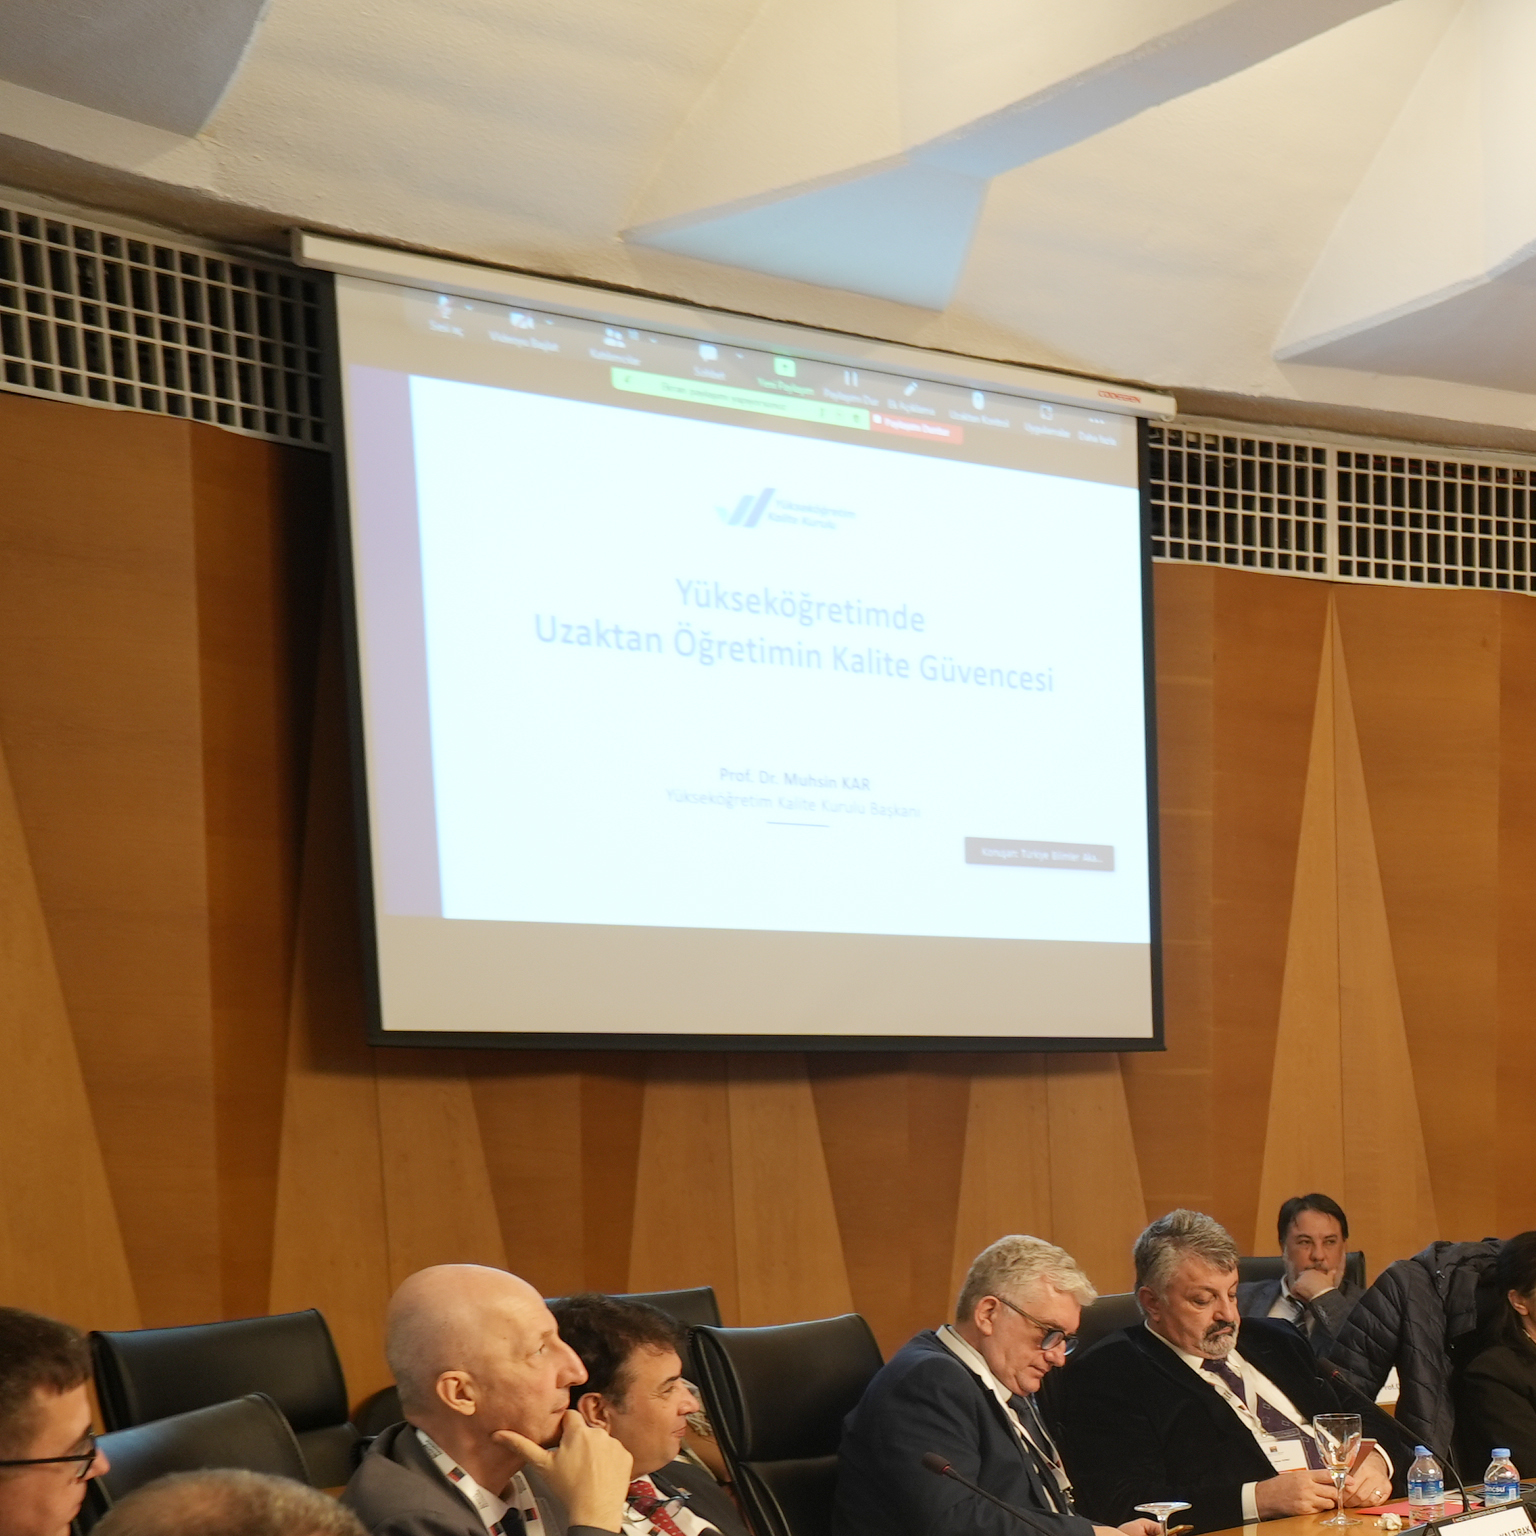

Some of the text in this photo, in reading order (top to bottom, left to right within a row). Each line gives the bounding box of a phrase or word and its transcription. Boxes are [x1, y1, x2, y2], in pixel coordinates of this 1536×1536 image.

[675, 578, 926, 633] Yükseköğretimde
[534, 613, 1054, 692] Uzaktan Öğretimin Kalite Güvencesi
[719, 767, 871, 791] Prof. Dr. Muhsin KAR
